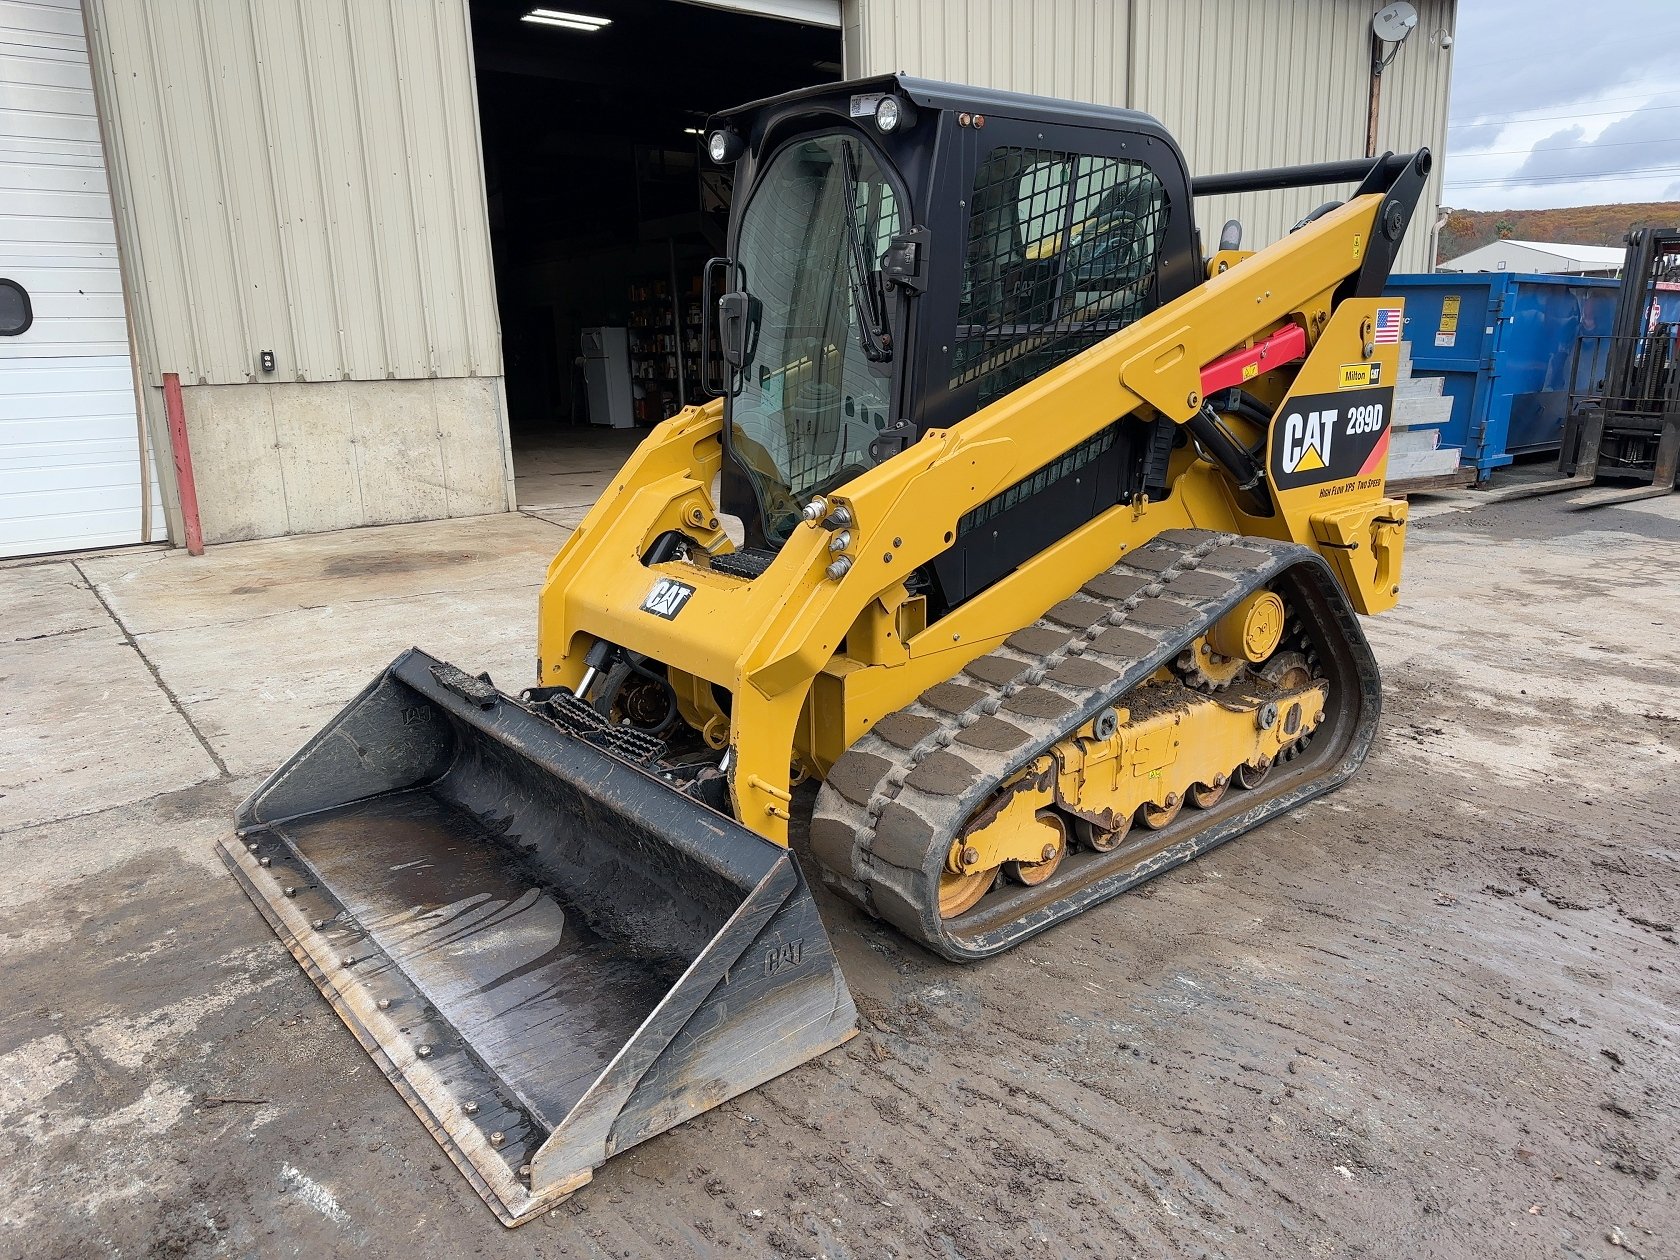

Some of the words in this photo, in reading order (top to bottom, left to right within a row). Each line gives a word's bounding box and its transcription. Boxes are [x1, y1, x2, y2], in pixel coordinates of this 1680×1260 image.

[1345, 370, 1366, 381] Milton
[1282, 409, 1338, 474] CAT
[1346, 404, 1383, 435] 289D
[1344, 482, 1356, 493] XPS
[646, 581, 691, 616] CAT
[764, 937, 804, 977] CAT
